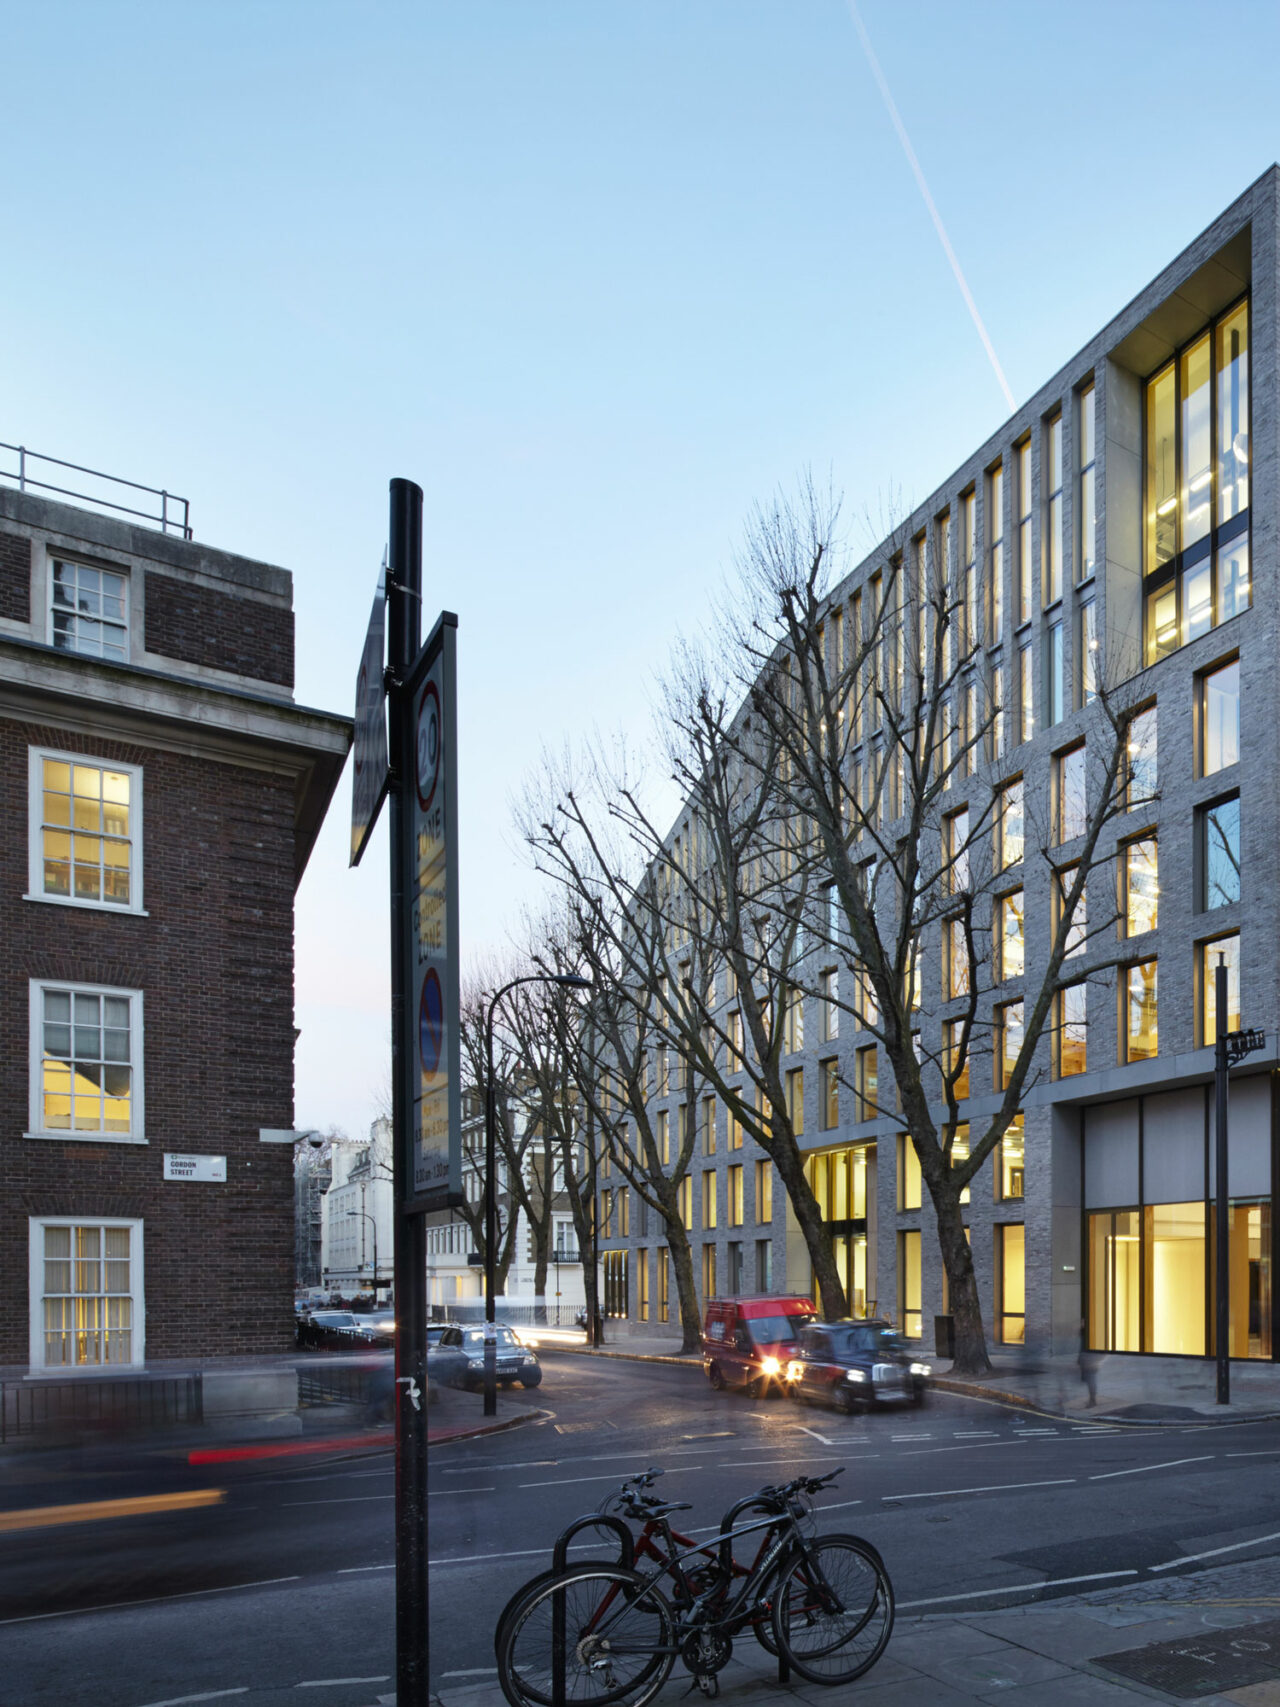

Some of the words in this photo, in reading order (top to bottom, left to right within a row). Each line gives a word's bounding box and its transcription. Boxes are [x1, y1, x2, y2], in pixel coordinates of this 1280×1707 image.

[419, 711, 437, 786] 20
[416, 807, 441, 862] ZONE
[418, 920, 441, 965] ZONE
